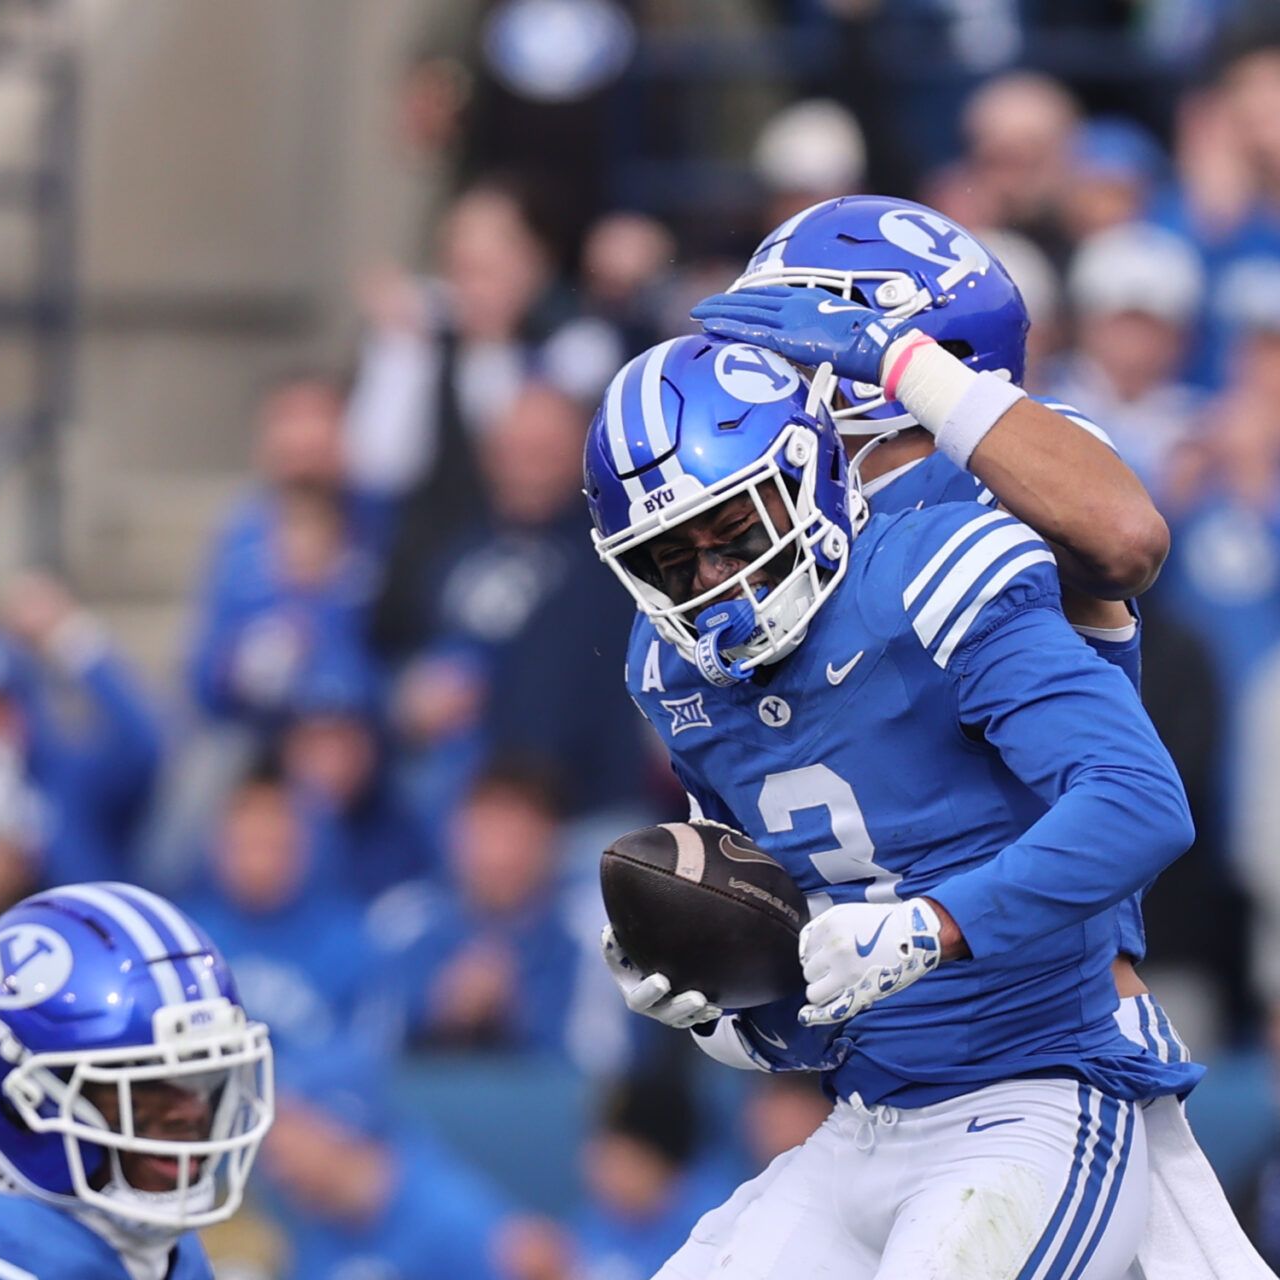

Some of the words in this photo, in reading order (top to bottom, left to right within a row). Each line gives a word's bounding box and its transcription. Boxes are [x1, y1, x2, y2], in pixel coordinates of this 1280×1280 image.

[893, 213, 968, 265] Y
[722, 346, 791, 392] Y
[643, 488, 675, 514] BYU
[758, 763, 903, 917] 3
